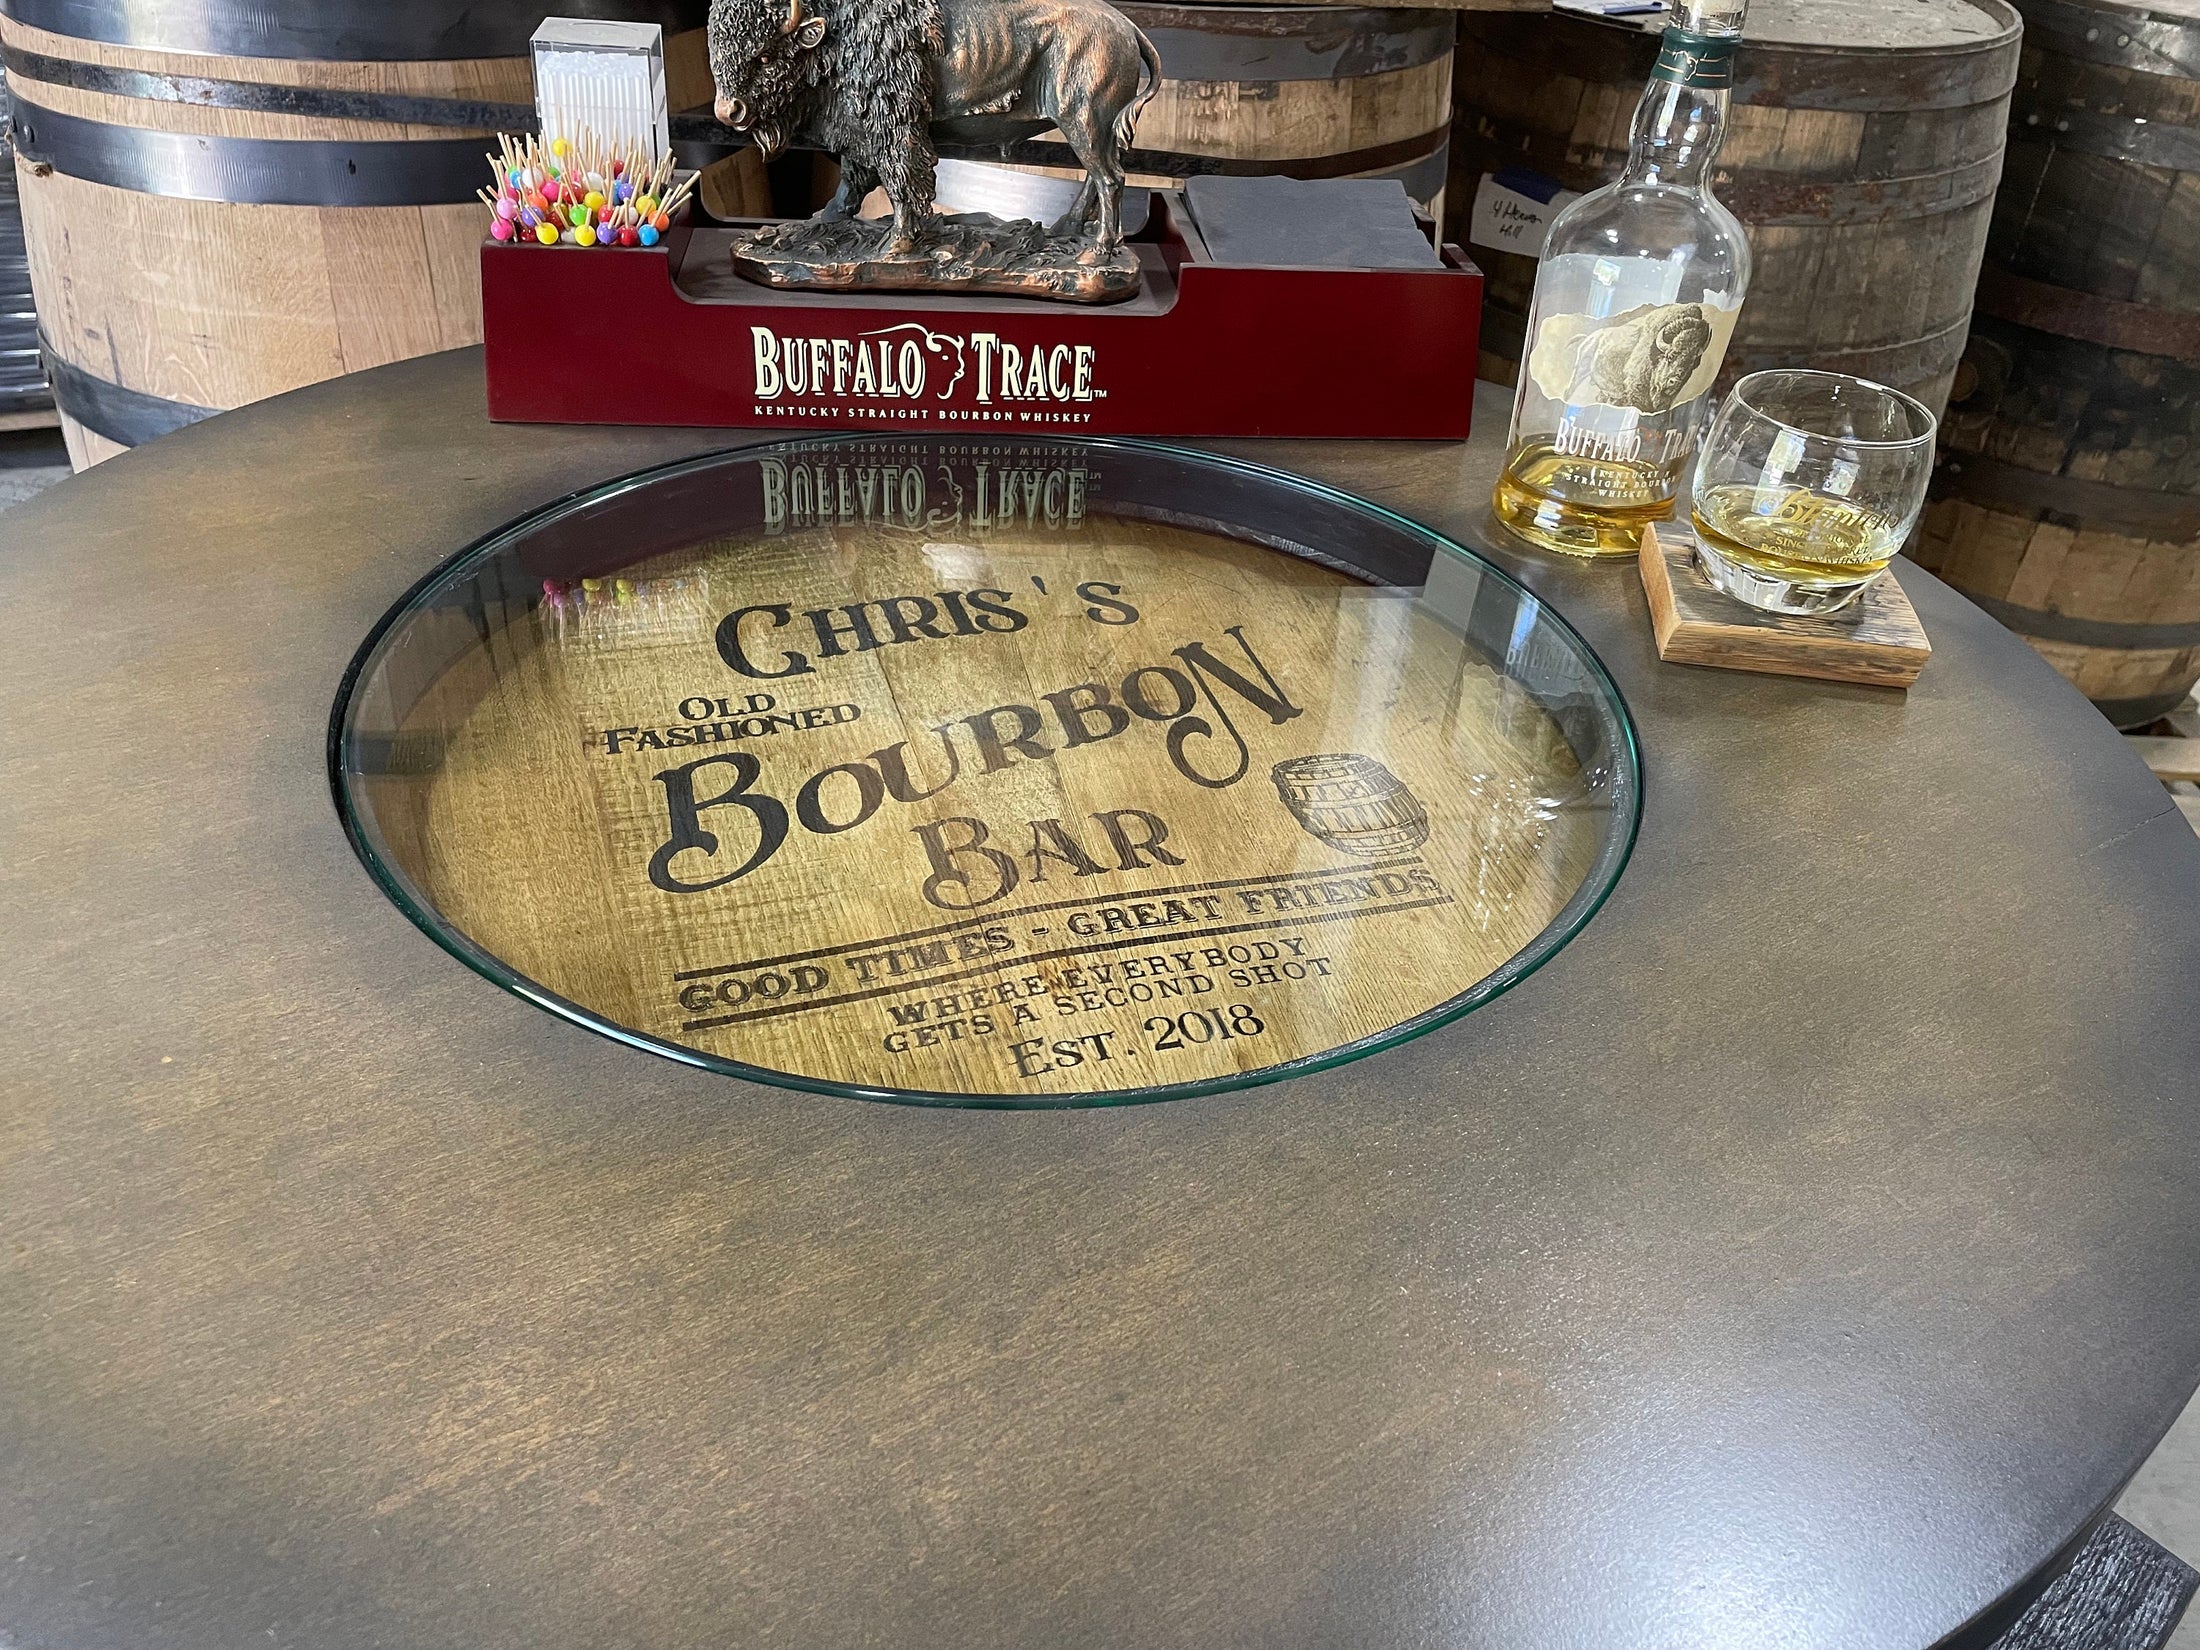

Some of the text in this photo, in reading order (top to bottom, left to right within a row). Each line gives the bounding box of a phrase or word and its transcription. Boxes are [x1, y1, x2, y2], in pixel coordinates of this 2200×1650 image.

[750, 326, 926, 400] BUFFALO
[970, 332, 1095, 405] TRACE
[754, 405, 1091, 423] KENTUCKY STRAIGHT BOURBON WHISKEY
[1553, 416, 1642, 463] BUFFALO
[602, 703, 862, 755] FASHIONED
[678, 693, 777, 721] OLD
[647, 625, 1304, 895] BOURBON
[909, 809, 1187, 911] BAR
[678, 965, 830, 1013] GOOD
[844, 926, 1017, 984] TIMES
[1066, 895, 1224, 938] GREAT
[1235, 868, 1441, 917] FRIENDS
[882, 956, 1333, 1054] GETS A SECOND SHOT
[886, 936, 1309, 1027] WHERE EVERYBODY
[1007, 1003, 1266, 1080] EST. 2018
